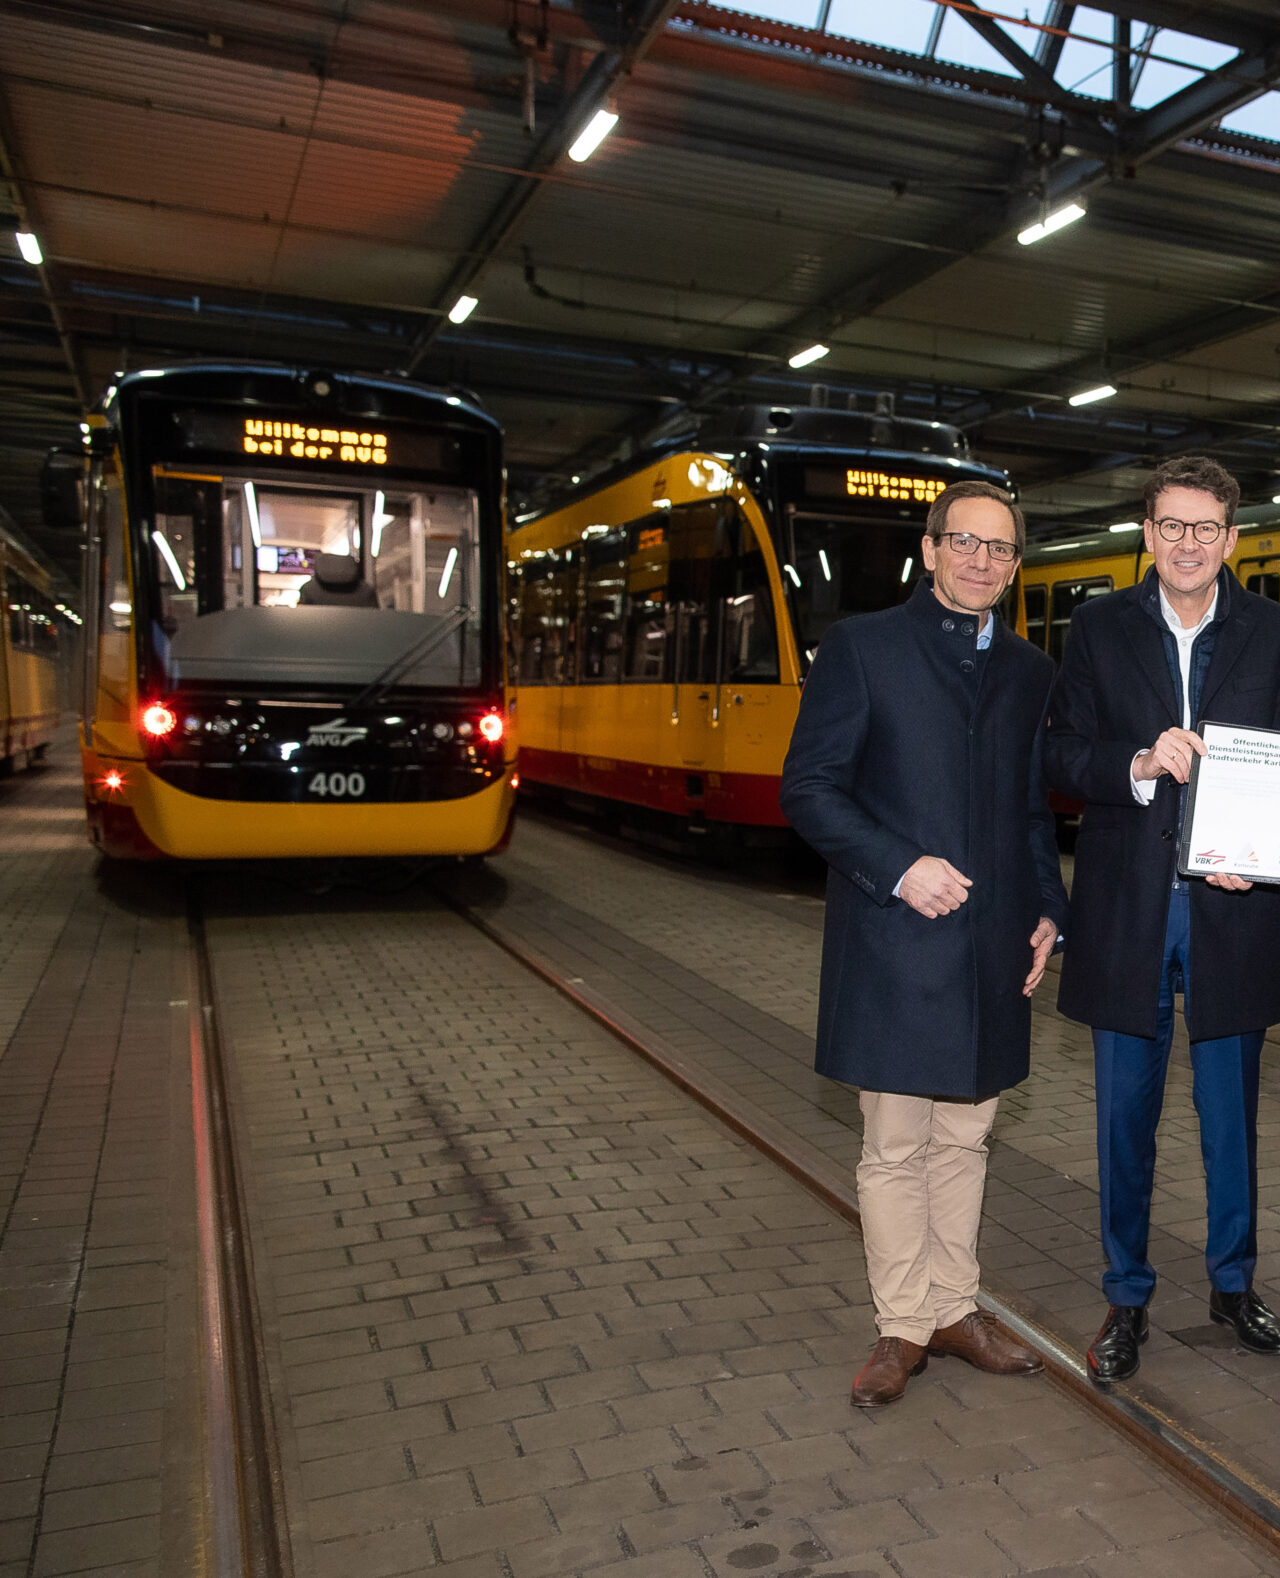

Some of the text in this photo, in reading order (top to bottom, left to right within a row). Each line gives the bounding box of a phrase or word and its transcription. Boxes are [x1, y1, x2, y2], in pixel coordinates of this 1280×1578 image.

[245, 419, 388, 448] Willkommen
[244, 436, 388, 465] bei der AVG
[847, 470, 947, 491] Willkommen
[847, 482, 875, 497] bei
[879, 485, 910, 500] den
[305, 733, 341, 747] AVG
[1207, 753, 1262, 765] Stadtverkehr
[308, 772, 366, 797] 400
[1195, 856, 1212, 865] VBK
